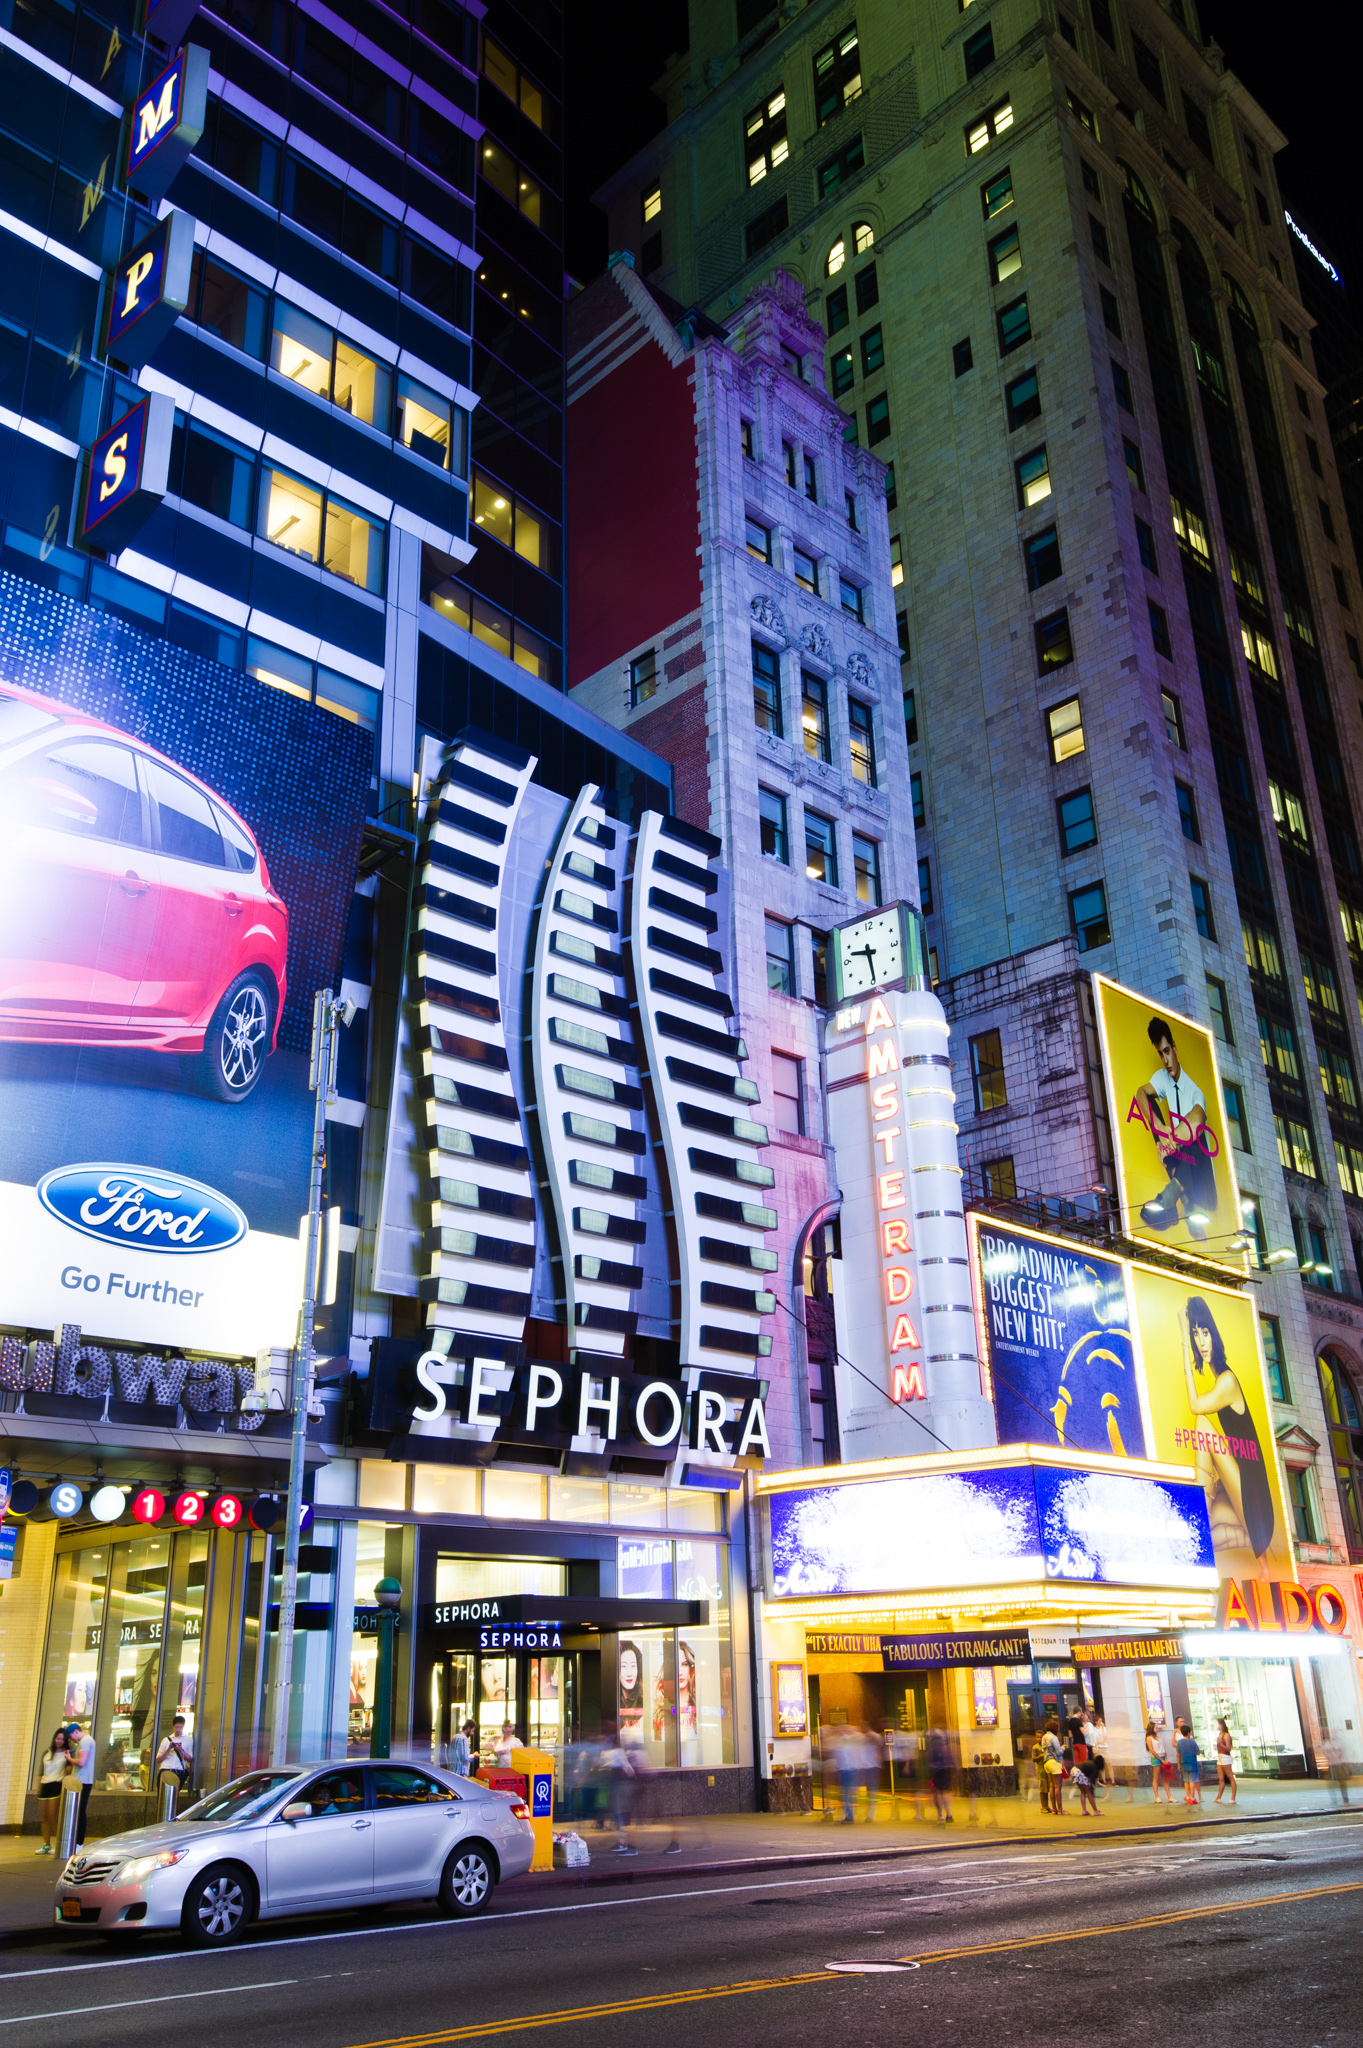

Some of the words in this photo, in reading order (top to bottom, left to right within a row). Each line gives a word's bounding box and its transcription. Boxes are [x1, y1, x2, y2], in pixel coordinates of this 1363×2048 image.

[864, 921, 874, 932] 12
[836, 1005, 862, 1031] NEW
[1126, 1095, 1219, 1158] ALDO
[80, 1174, 211, 1245] Ford
[866, 998, 928, 1404] AMSTERDAM
[60, 1265, 101, 1293] Go
[106, 1272, 204, 1308] Further
[990, 1272, 1053, 1316] BIGGEST
[992, 1304, 1027, 1343] NEW
[412, 1350, 772, 1459] SEPHORA
[1174, 1426, 1259, 1462] #PERFECTPAIR
[56, 1487, 77, 1512] S
[142, 1495, 156, 1518] 1
[183, 1497, 198, 1521] 2
[219, 1500, 235, 1523] 3
[435, 1601, 500, 1624] SEPHORA
[1222, 1577, 1348, 1635] ALDO
[480, 1632, 561, 1648] SEPHORA
[828, 1635, 861, 1652] EXACTLY
